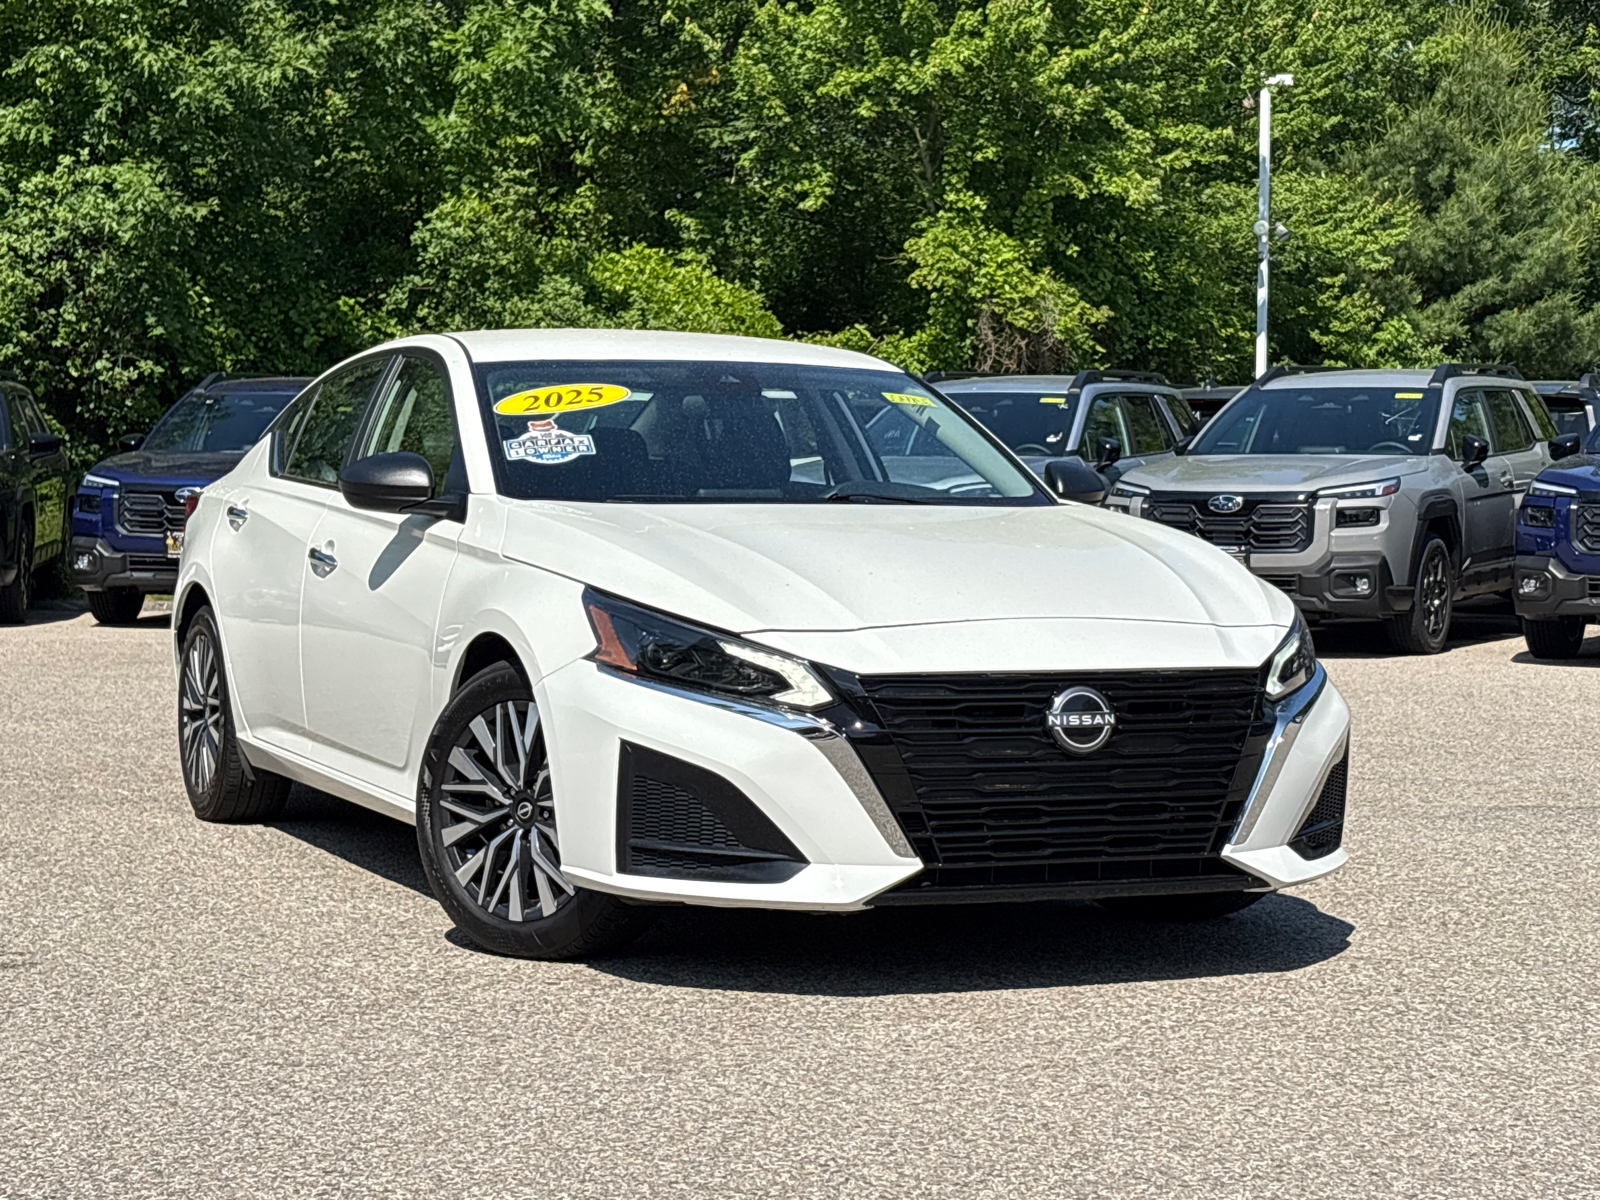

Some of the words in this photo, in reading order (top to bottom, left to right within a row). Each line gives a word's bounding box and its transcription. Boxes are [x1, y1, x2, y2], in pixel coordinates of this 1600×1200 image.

[523, 387, 604, 412] 2025
[510, 438, 588, 449] CARFAX
[525, 445, 590, 456] OWNER
[1048, 713, 1115, 726] NISSAN
